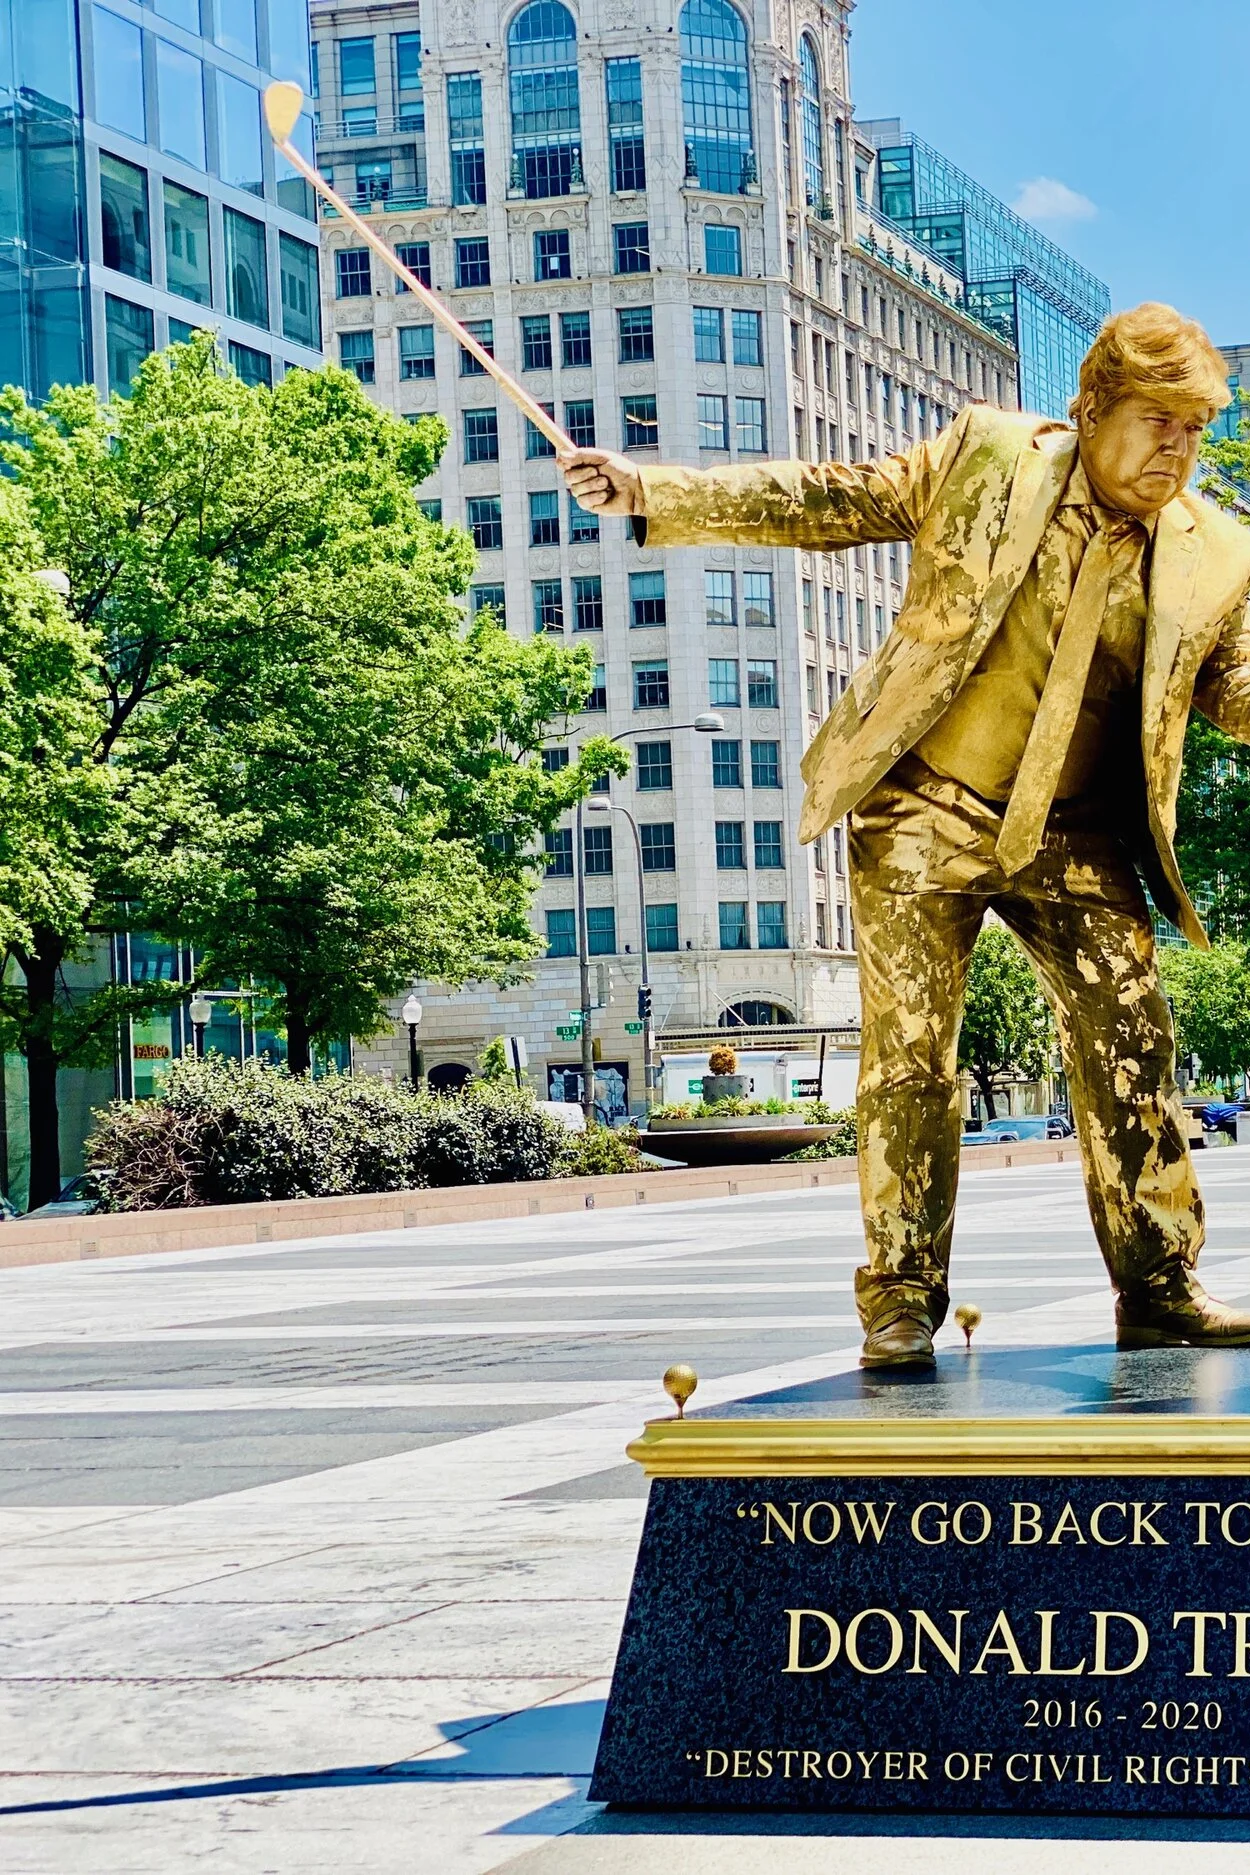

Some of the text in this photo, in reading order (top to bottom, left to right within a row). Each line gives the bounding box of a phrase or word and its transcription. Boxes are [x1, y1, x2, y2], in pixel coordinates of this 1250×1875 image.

[136, 1045, 170, 1058] FARGO
[736, 1502, 897, 1545] “NOW
[911, 1501, 992, 1545] GO
[1007, 1501, 1170, 1546] BACK
[781, 1608, 1149, 1676] DONALD
[1023, 1699, 1103, 1728] 2016
[1141, 1701, 1222, 1730] 2020
[686, 1749, 929, 1780] “DESTROYER
[944, 1752, 993, 1781] OF
[1005, 1753, 1113, 1783] CIVIL
